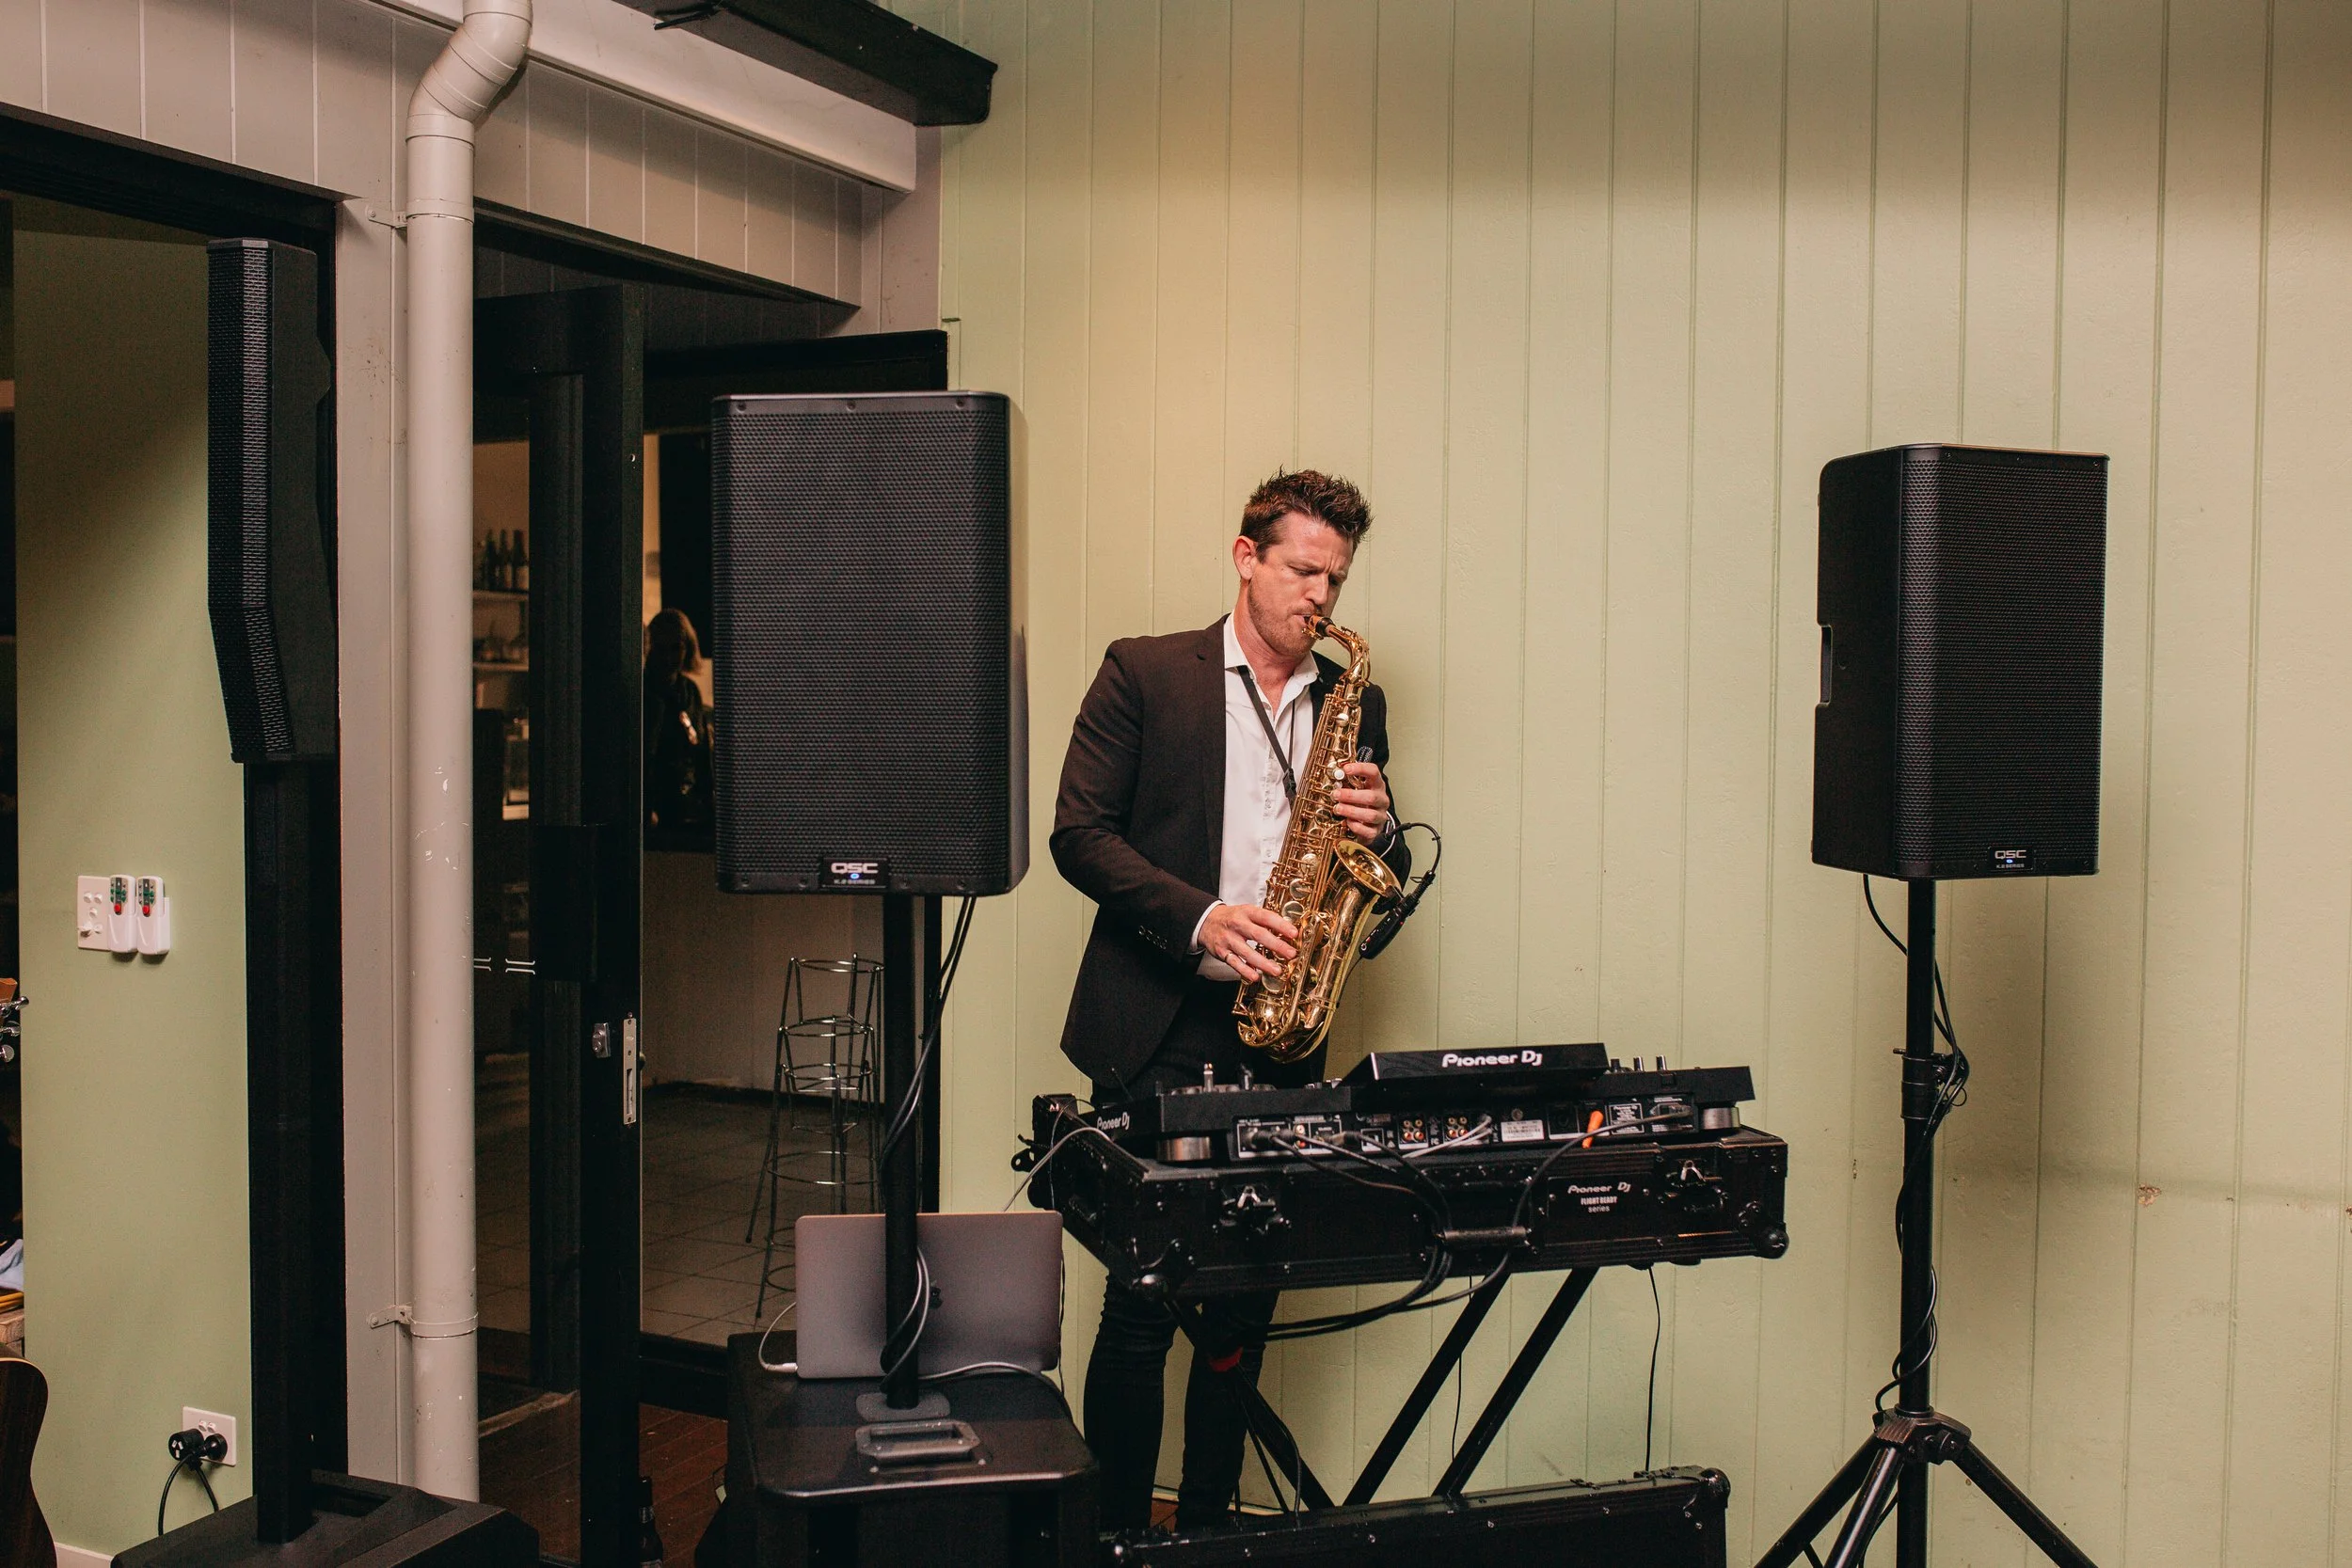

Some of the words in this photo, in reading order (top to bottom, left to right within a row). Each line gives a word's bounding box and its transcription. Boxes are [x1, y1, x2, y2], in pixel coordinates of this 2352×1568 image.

[1994, 849, 2026, 860] QSC
[831, 863, 879, 874] QSC
[1441, 1053, 1518, 1069] Pioneer
[1096, 1117, 1121, 1131] Pioneer
[1566, 1184, 1613, 1195] Pioneer
[1587, 1205, 1611, 1213] series
